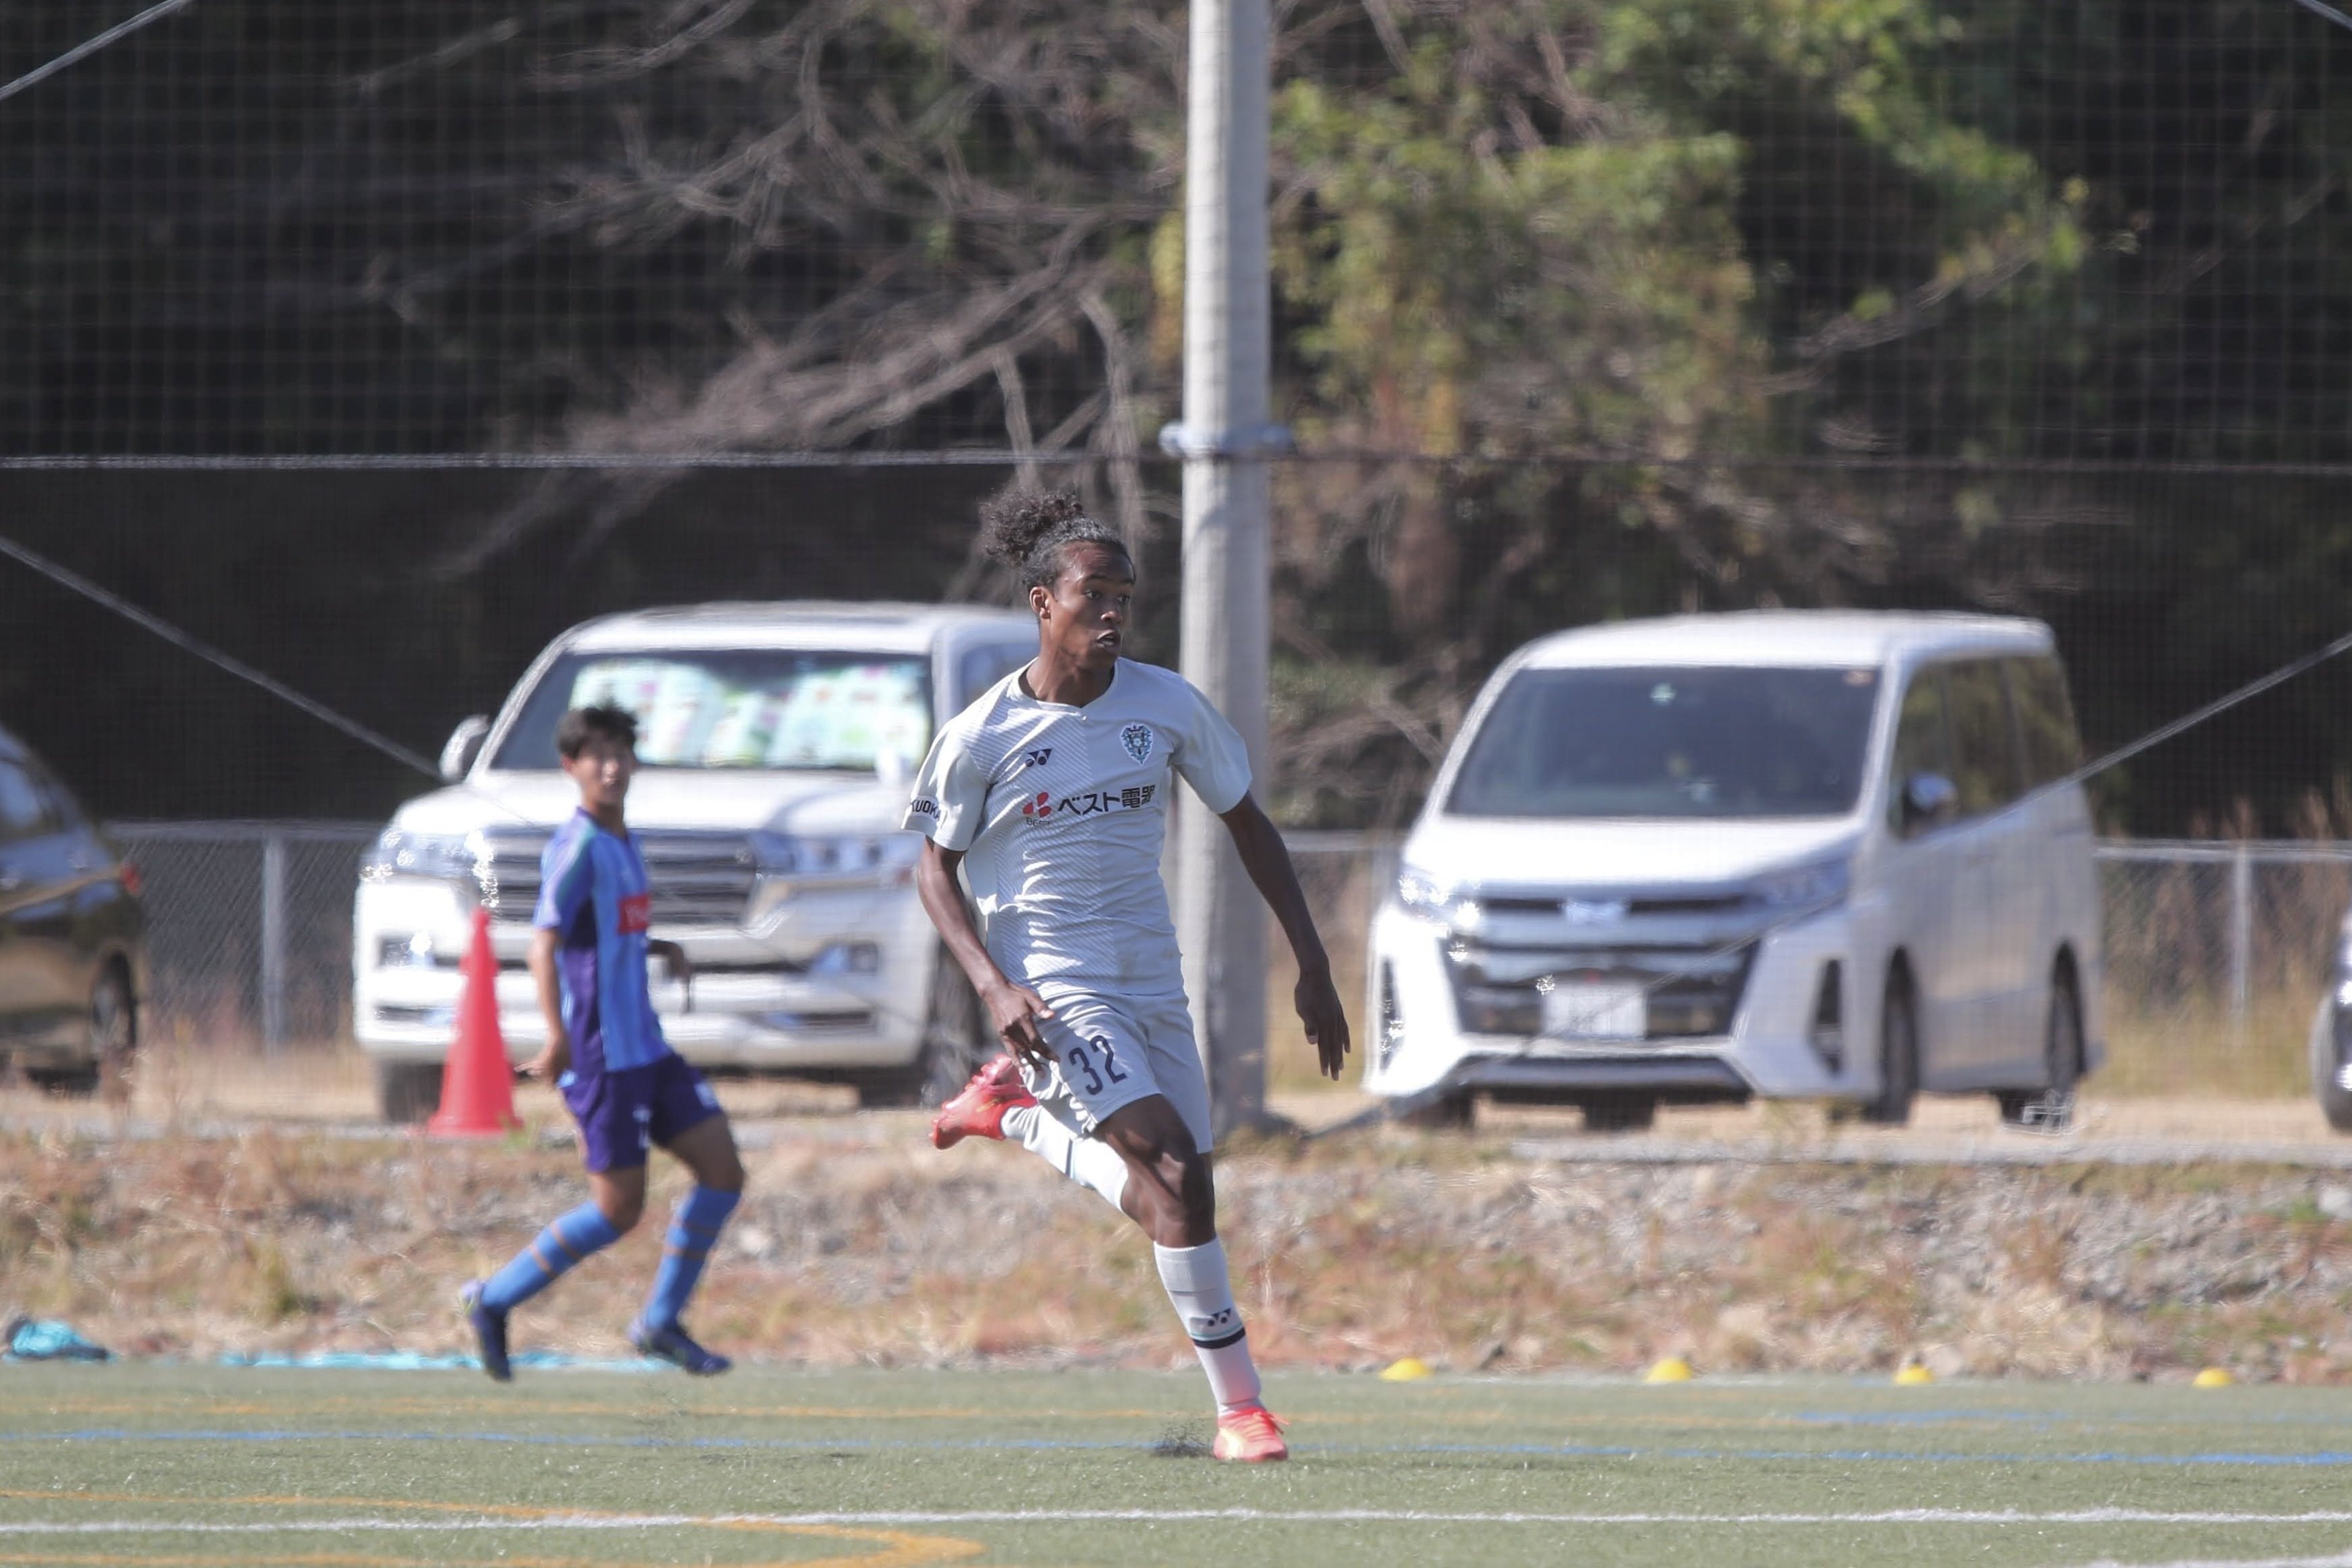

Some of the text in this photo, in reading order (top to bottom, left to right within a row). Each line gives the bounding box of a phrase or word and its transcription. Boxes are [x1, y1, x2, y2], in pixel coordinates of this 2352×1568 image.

[1058, 784, 1156, 816] ベスト電器
[1068, 1035, 1127, 1095] 32
